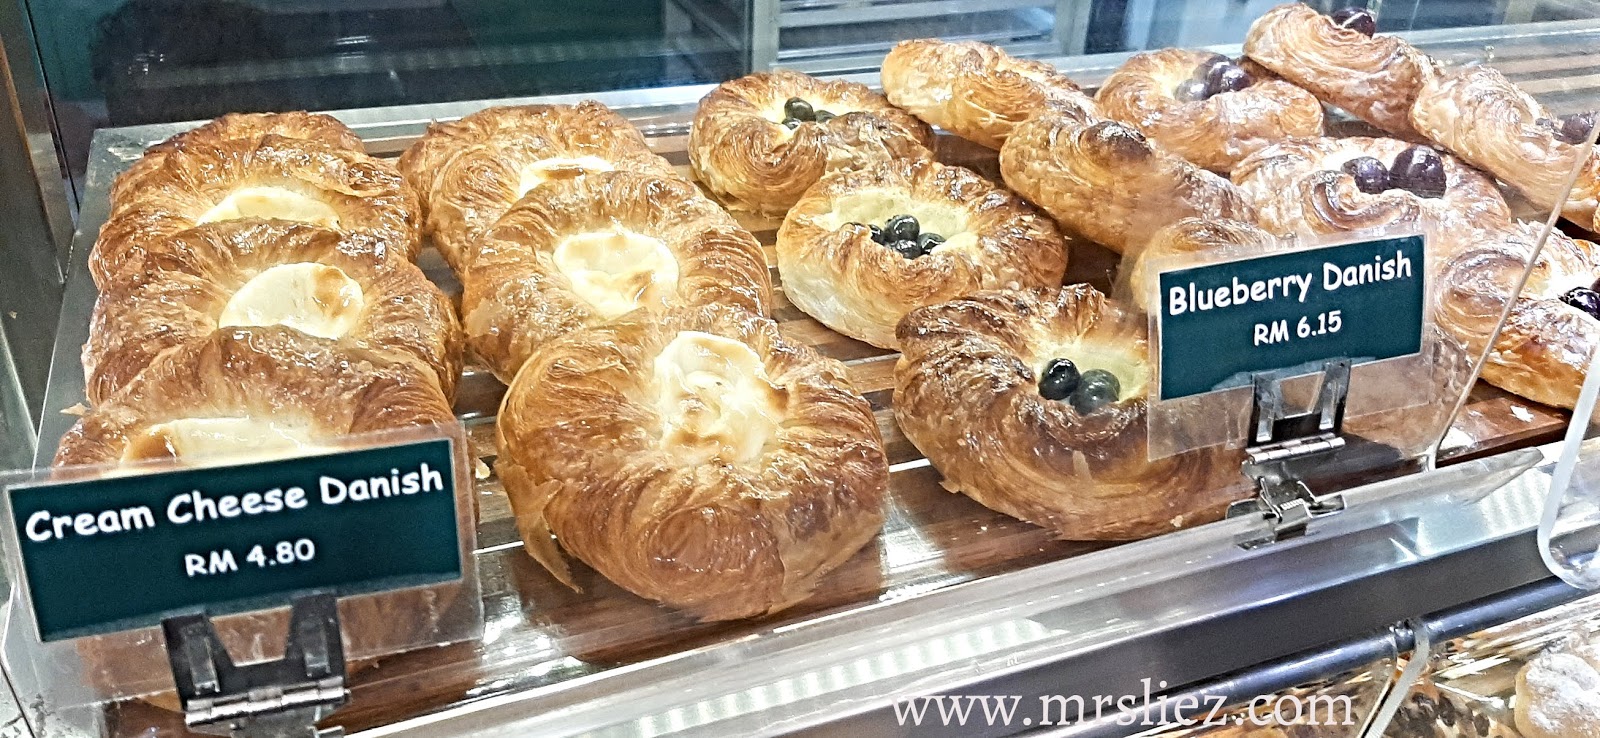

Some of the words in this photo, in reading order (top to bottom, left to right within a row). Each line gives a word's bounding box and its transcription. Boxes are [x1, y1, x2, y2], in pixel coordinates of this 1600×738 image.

[1169, 272, 1313, 316] Blueberry
[1322, 249, 1412, 291] Danish
[1253, 319, 1290, 347] RM
[1296, 309, 1342, 339] 6.15
[25, 506, 155, 542] Cream
[166, 487, 308, 524] Cheese
[319, 462, 444, 505] Danish
[184, 549, 238, 577] RM
[246, 538, 315, 567] 4.80
